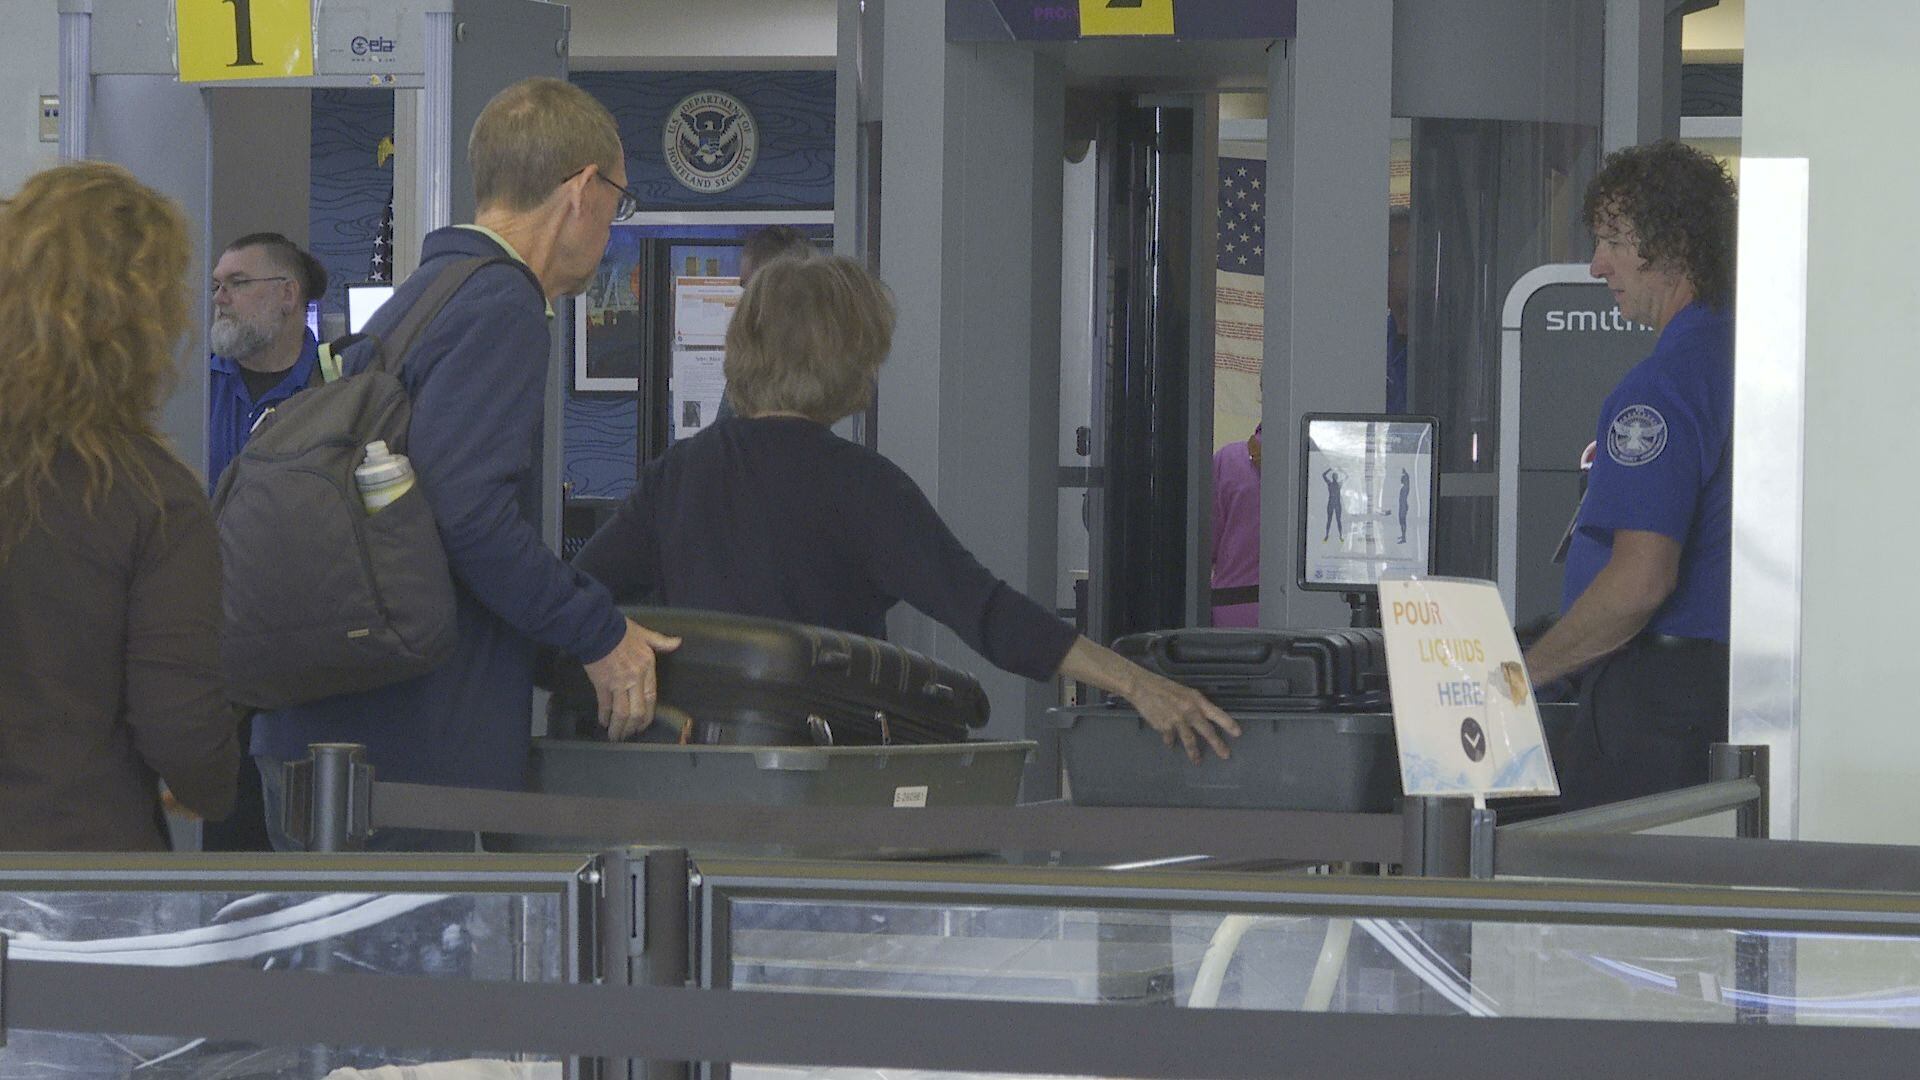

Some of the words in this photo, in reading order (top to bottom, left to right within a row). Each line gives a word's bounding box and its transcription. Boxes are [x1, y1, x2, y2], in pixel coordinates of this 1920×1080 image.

[222, 0, 264, 67] 1
[682, 95, 746, 120] DEPARTMENT
[668, 147, 711, 188] HOMELAND
[715, 146, 752, 188] SECURITY
[1546, 306, 1654, 331] smit
[1392, 600, 1444, 625] POUR
[1418, 638, 1485, 668] LIQUIDS
[1438, 681, 1486, 706] HERE
